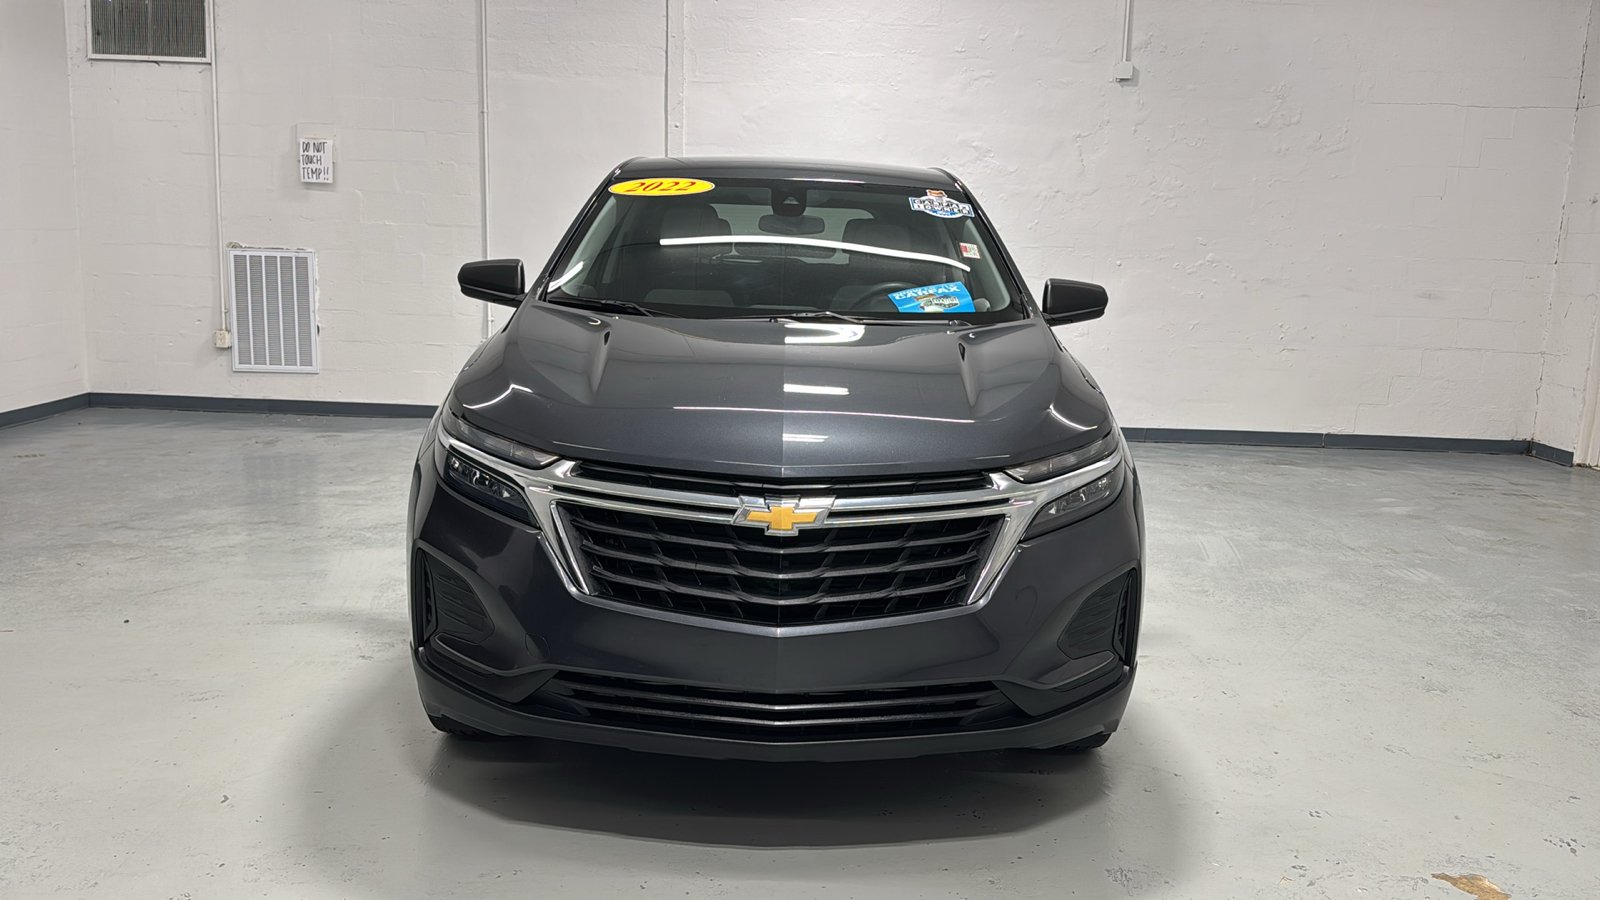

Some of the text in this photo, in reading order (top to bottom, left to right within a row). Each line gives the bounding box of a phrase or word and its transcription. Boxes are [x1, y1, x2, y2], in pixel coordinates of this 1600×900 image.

[302, 141, 327, 154] DO NOT
[301, 154, 322, 166] TOUCH
[302, 166, 329, 181] TEMP!!
[623, 181, 697, 193] 2022
[894, 285, 960, 300] CARFAX
